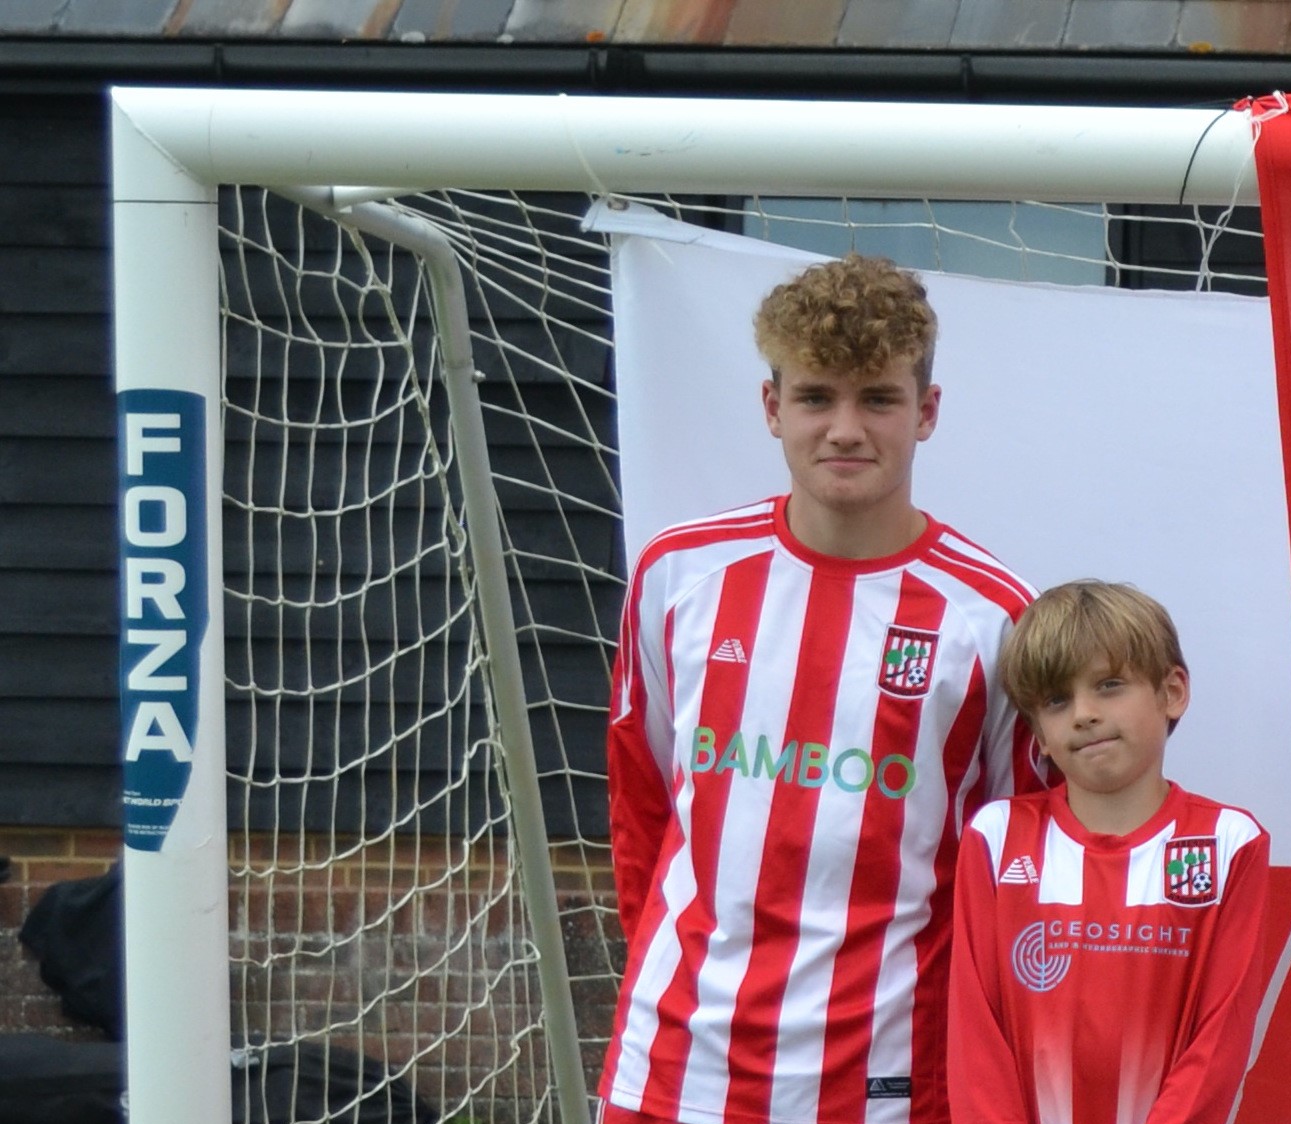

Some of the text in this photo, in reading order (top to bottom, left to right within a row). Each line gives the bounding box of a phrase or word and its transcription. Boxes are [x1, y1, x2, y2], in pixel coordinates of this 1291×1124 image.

[125, 412, 193, 762] FORZA
[690, 727, 917, 799] BAMBOO
[1049, 920, 1192, 944] GEOSIGHT
